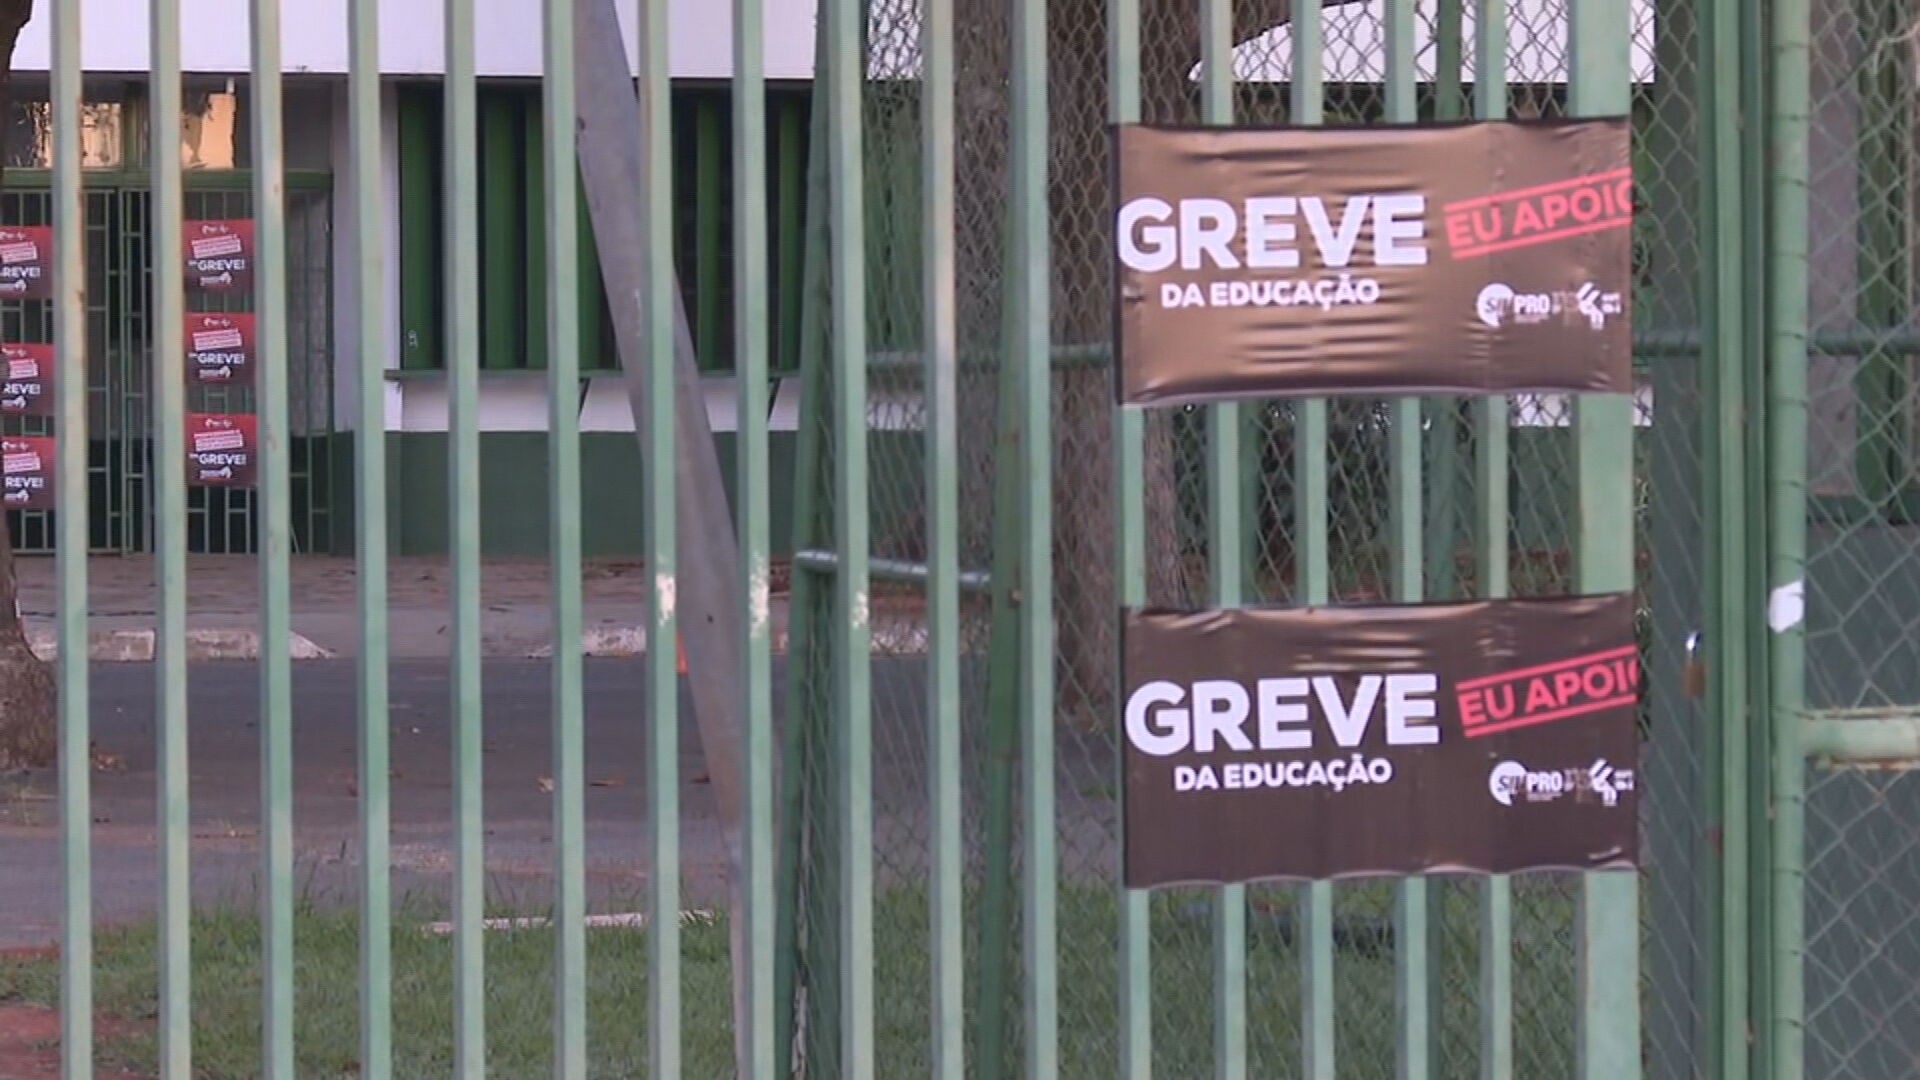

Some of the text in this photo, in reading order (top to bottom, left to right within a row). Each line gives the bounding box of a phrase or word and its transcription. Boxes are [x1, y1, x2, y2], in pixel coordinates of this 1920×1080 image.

[1118, 195, 1427, 272] GREVE
[1445, 209, 1502, 247] EU
[197, 259, 245, 271] GREVE!
[1161, 273, 1381, 311] DA EDUCAÇÃO
[197, 353, 245, 365] GREVE!
[1125, 674, 1439, 756] GREVE
[1458, 683, 1515, 727] EU
[1174, 753, 1392, 792] DA EDUCAÇÃO
